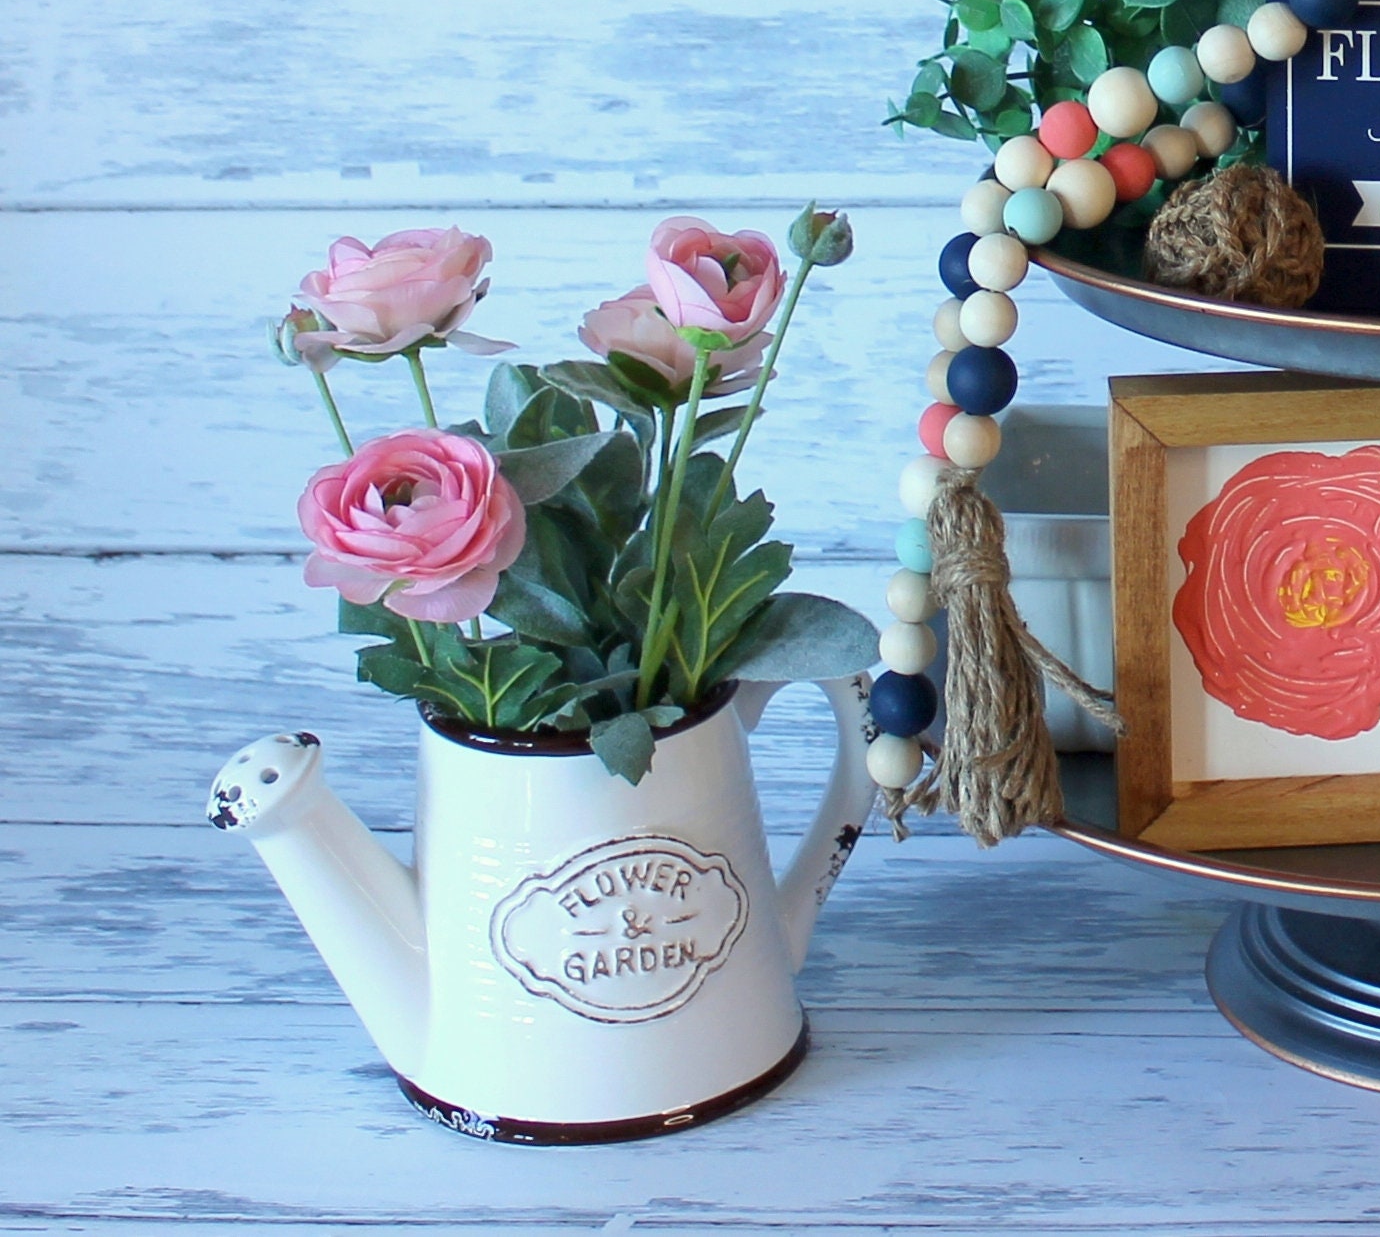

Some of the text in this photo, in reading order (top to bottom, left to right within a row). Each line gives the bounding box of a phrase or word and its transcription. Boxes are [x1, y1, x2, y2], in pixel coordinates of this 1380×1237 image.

[558, 861, 693, 918] FLOWER
[621, 908, 652, 940] &
[563, 940, 697, 985] GARDEN
